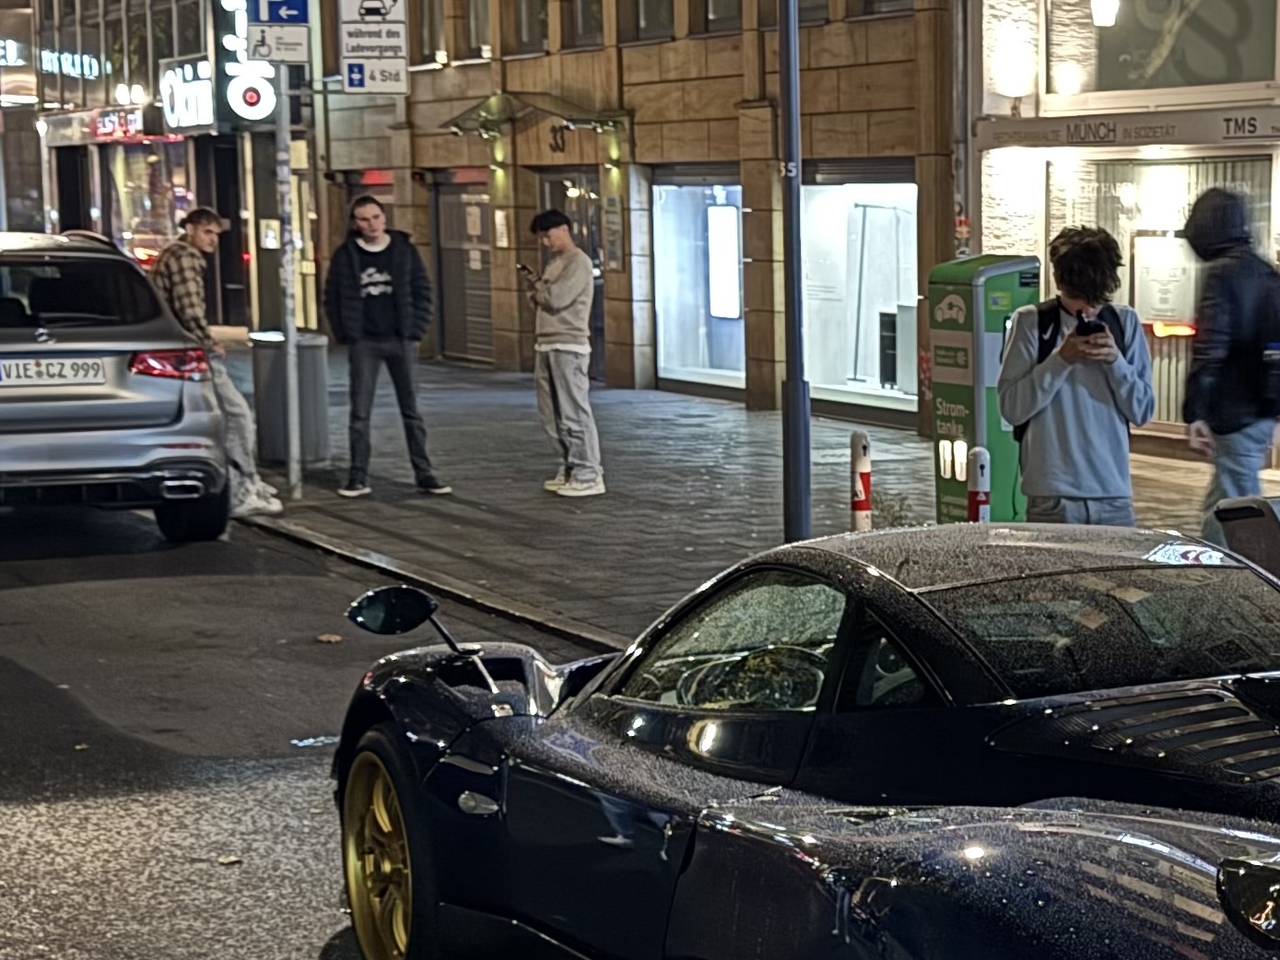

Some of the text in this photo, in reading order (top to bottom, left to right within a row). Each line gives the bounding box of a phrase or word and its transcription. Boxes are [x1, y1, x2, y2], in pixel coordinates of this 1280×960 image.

[346, 28, 400, 39] während des
[346, 43, 402, 57] Ladevorgangs
[369, 70, 402, 82] 4 Std.
[1066, 119, 1117, 142] MÜNCH
[1123, 128, 1133, 139] IN
[1223, 117, 1258, 135] TMS
[2, 361, 100, 379] VIE CZ 999
[936, 398, 969, 417] Strom-
[936, 418, 964, 436] tanke
